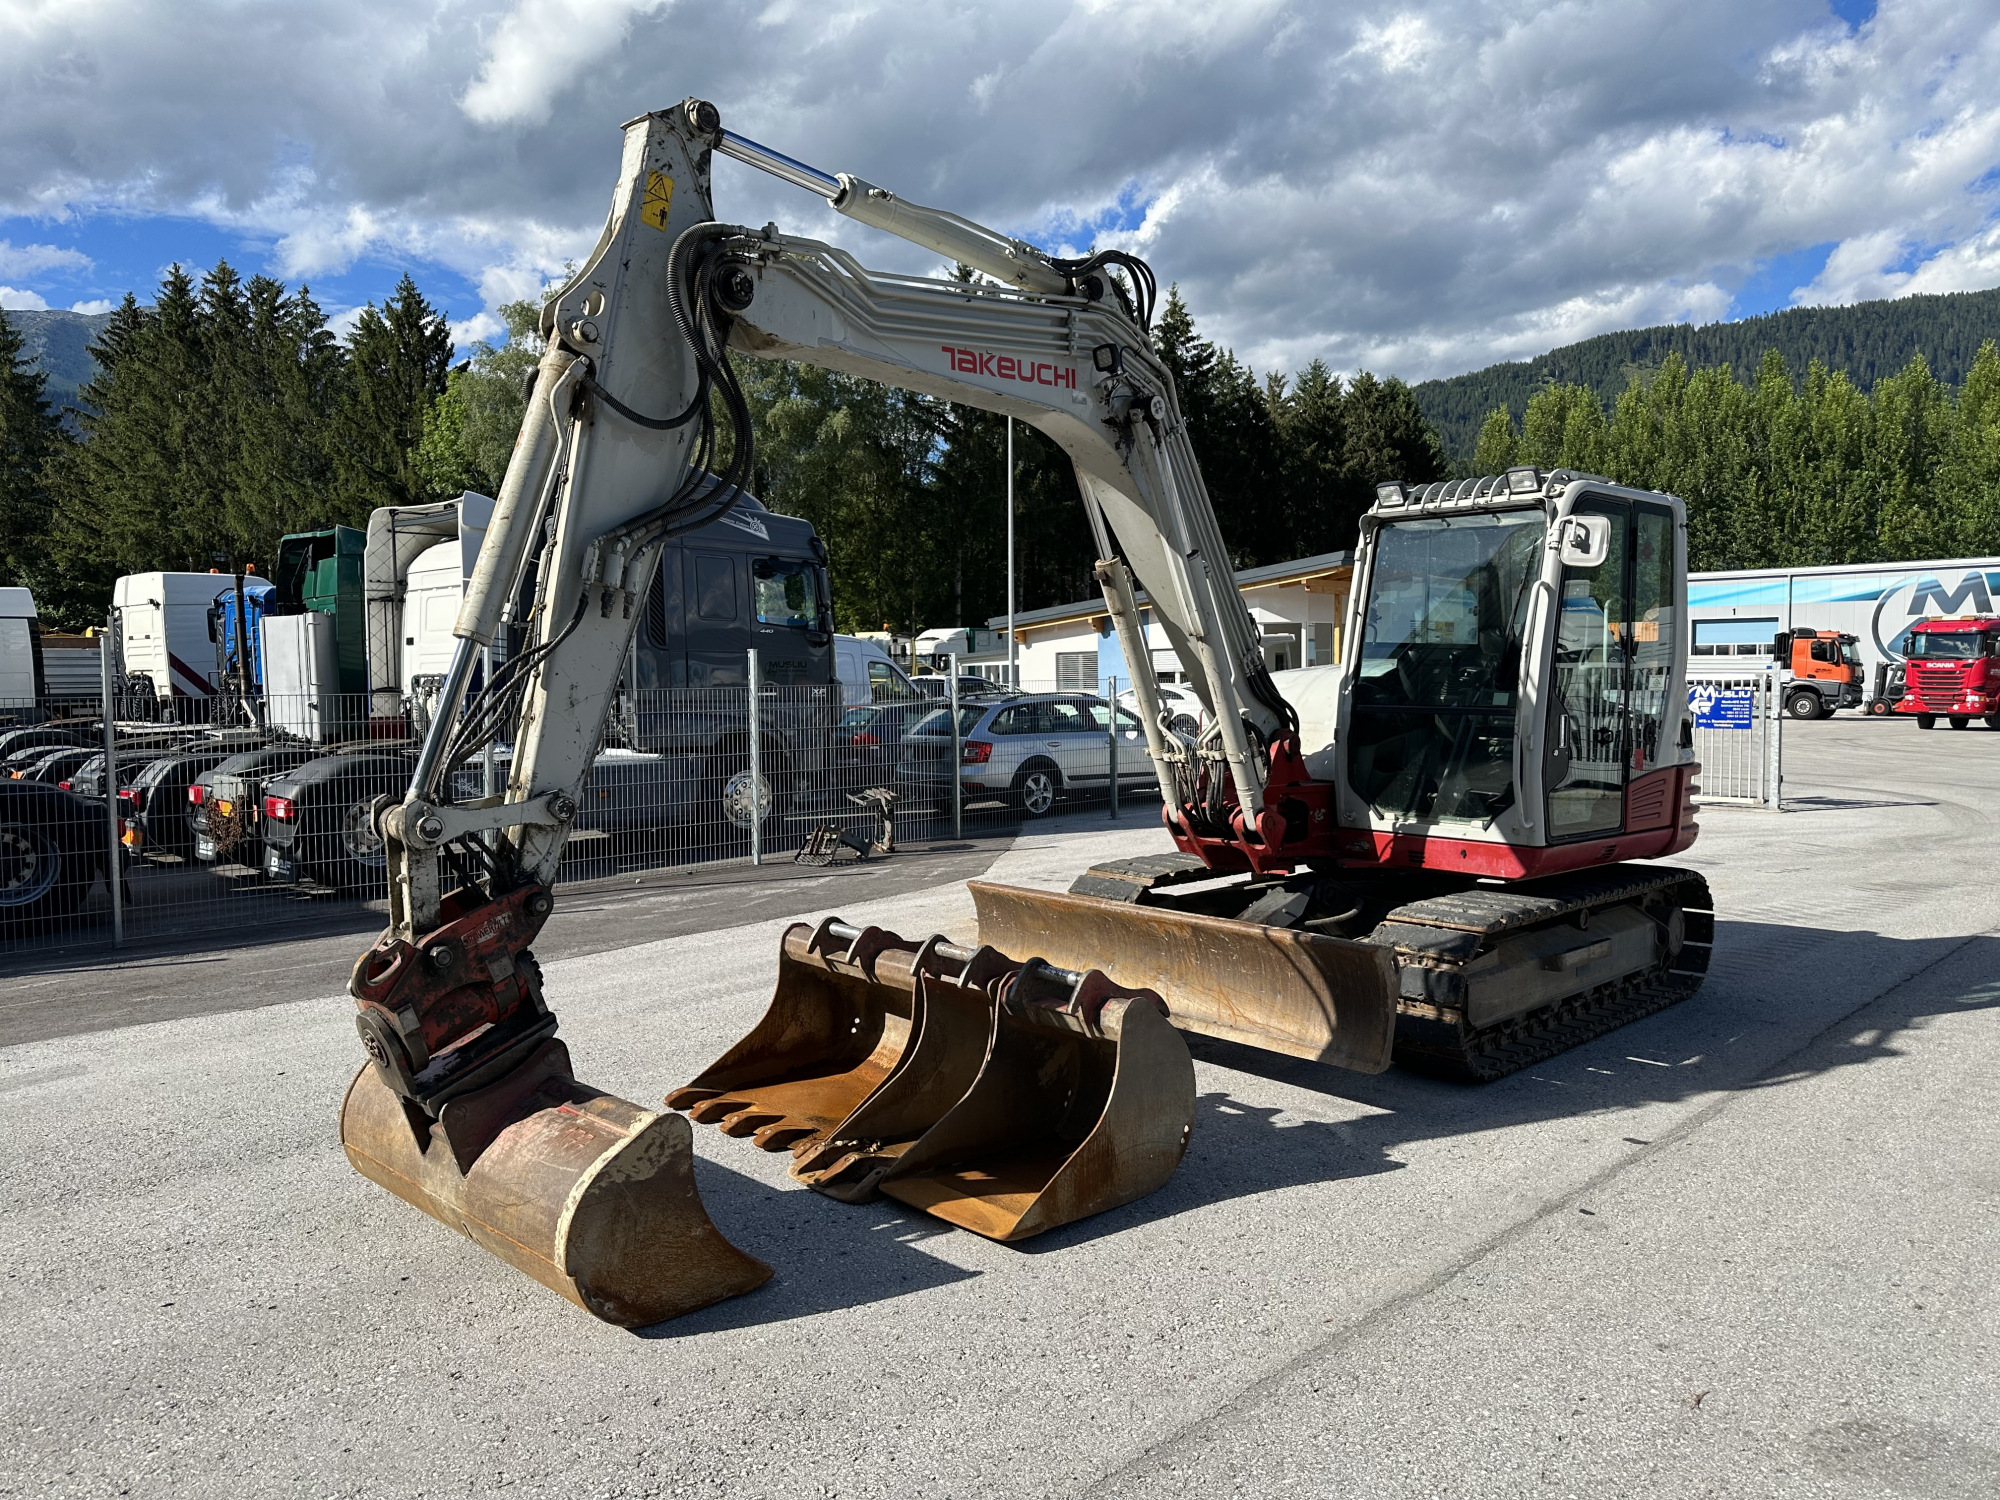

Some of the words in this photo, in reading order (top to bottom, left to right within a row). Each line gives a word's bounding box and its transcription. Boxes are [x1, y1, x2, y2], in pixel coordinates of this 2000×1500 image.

[1732, 608, 1736, 616] 1
[1694, 685, 1751, 698] MUSLIU
[271, 856, 291, 869] DAF
